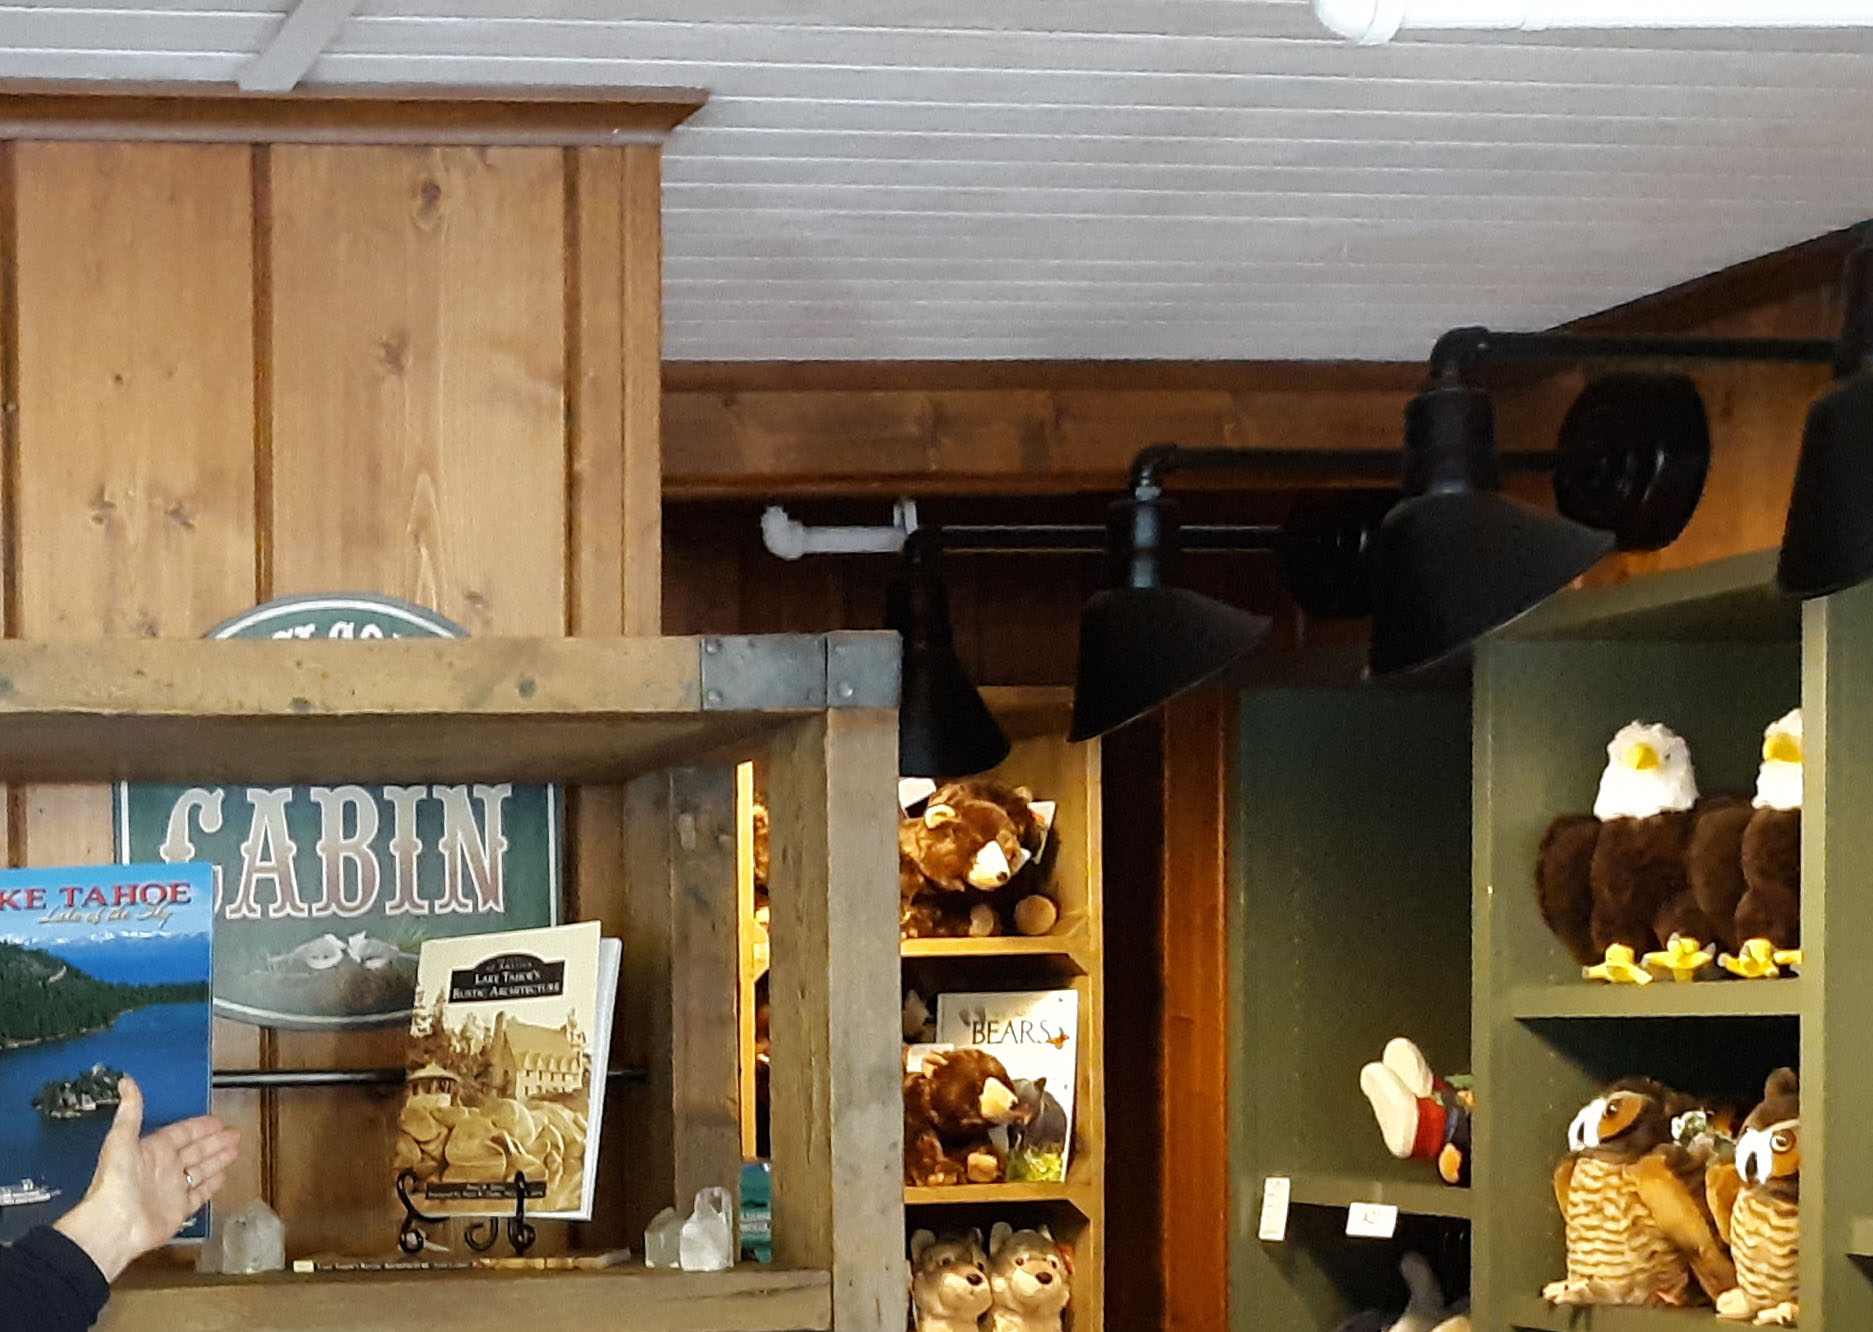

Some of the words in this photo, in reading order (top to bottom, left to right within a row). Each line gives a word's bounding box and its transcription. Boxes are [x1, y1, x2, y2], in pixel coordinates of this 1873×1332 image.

[159, 783, 513, 919] CABIN
[59, 882, 192, 908] TAHOE
[136, 901, 173, 929] Sky
[972, 1020, 1050, 1045] BEARS
